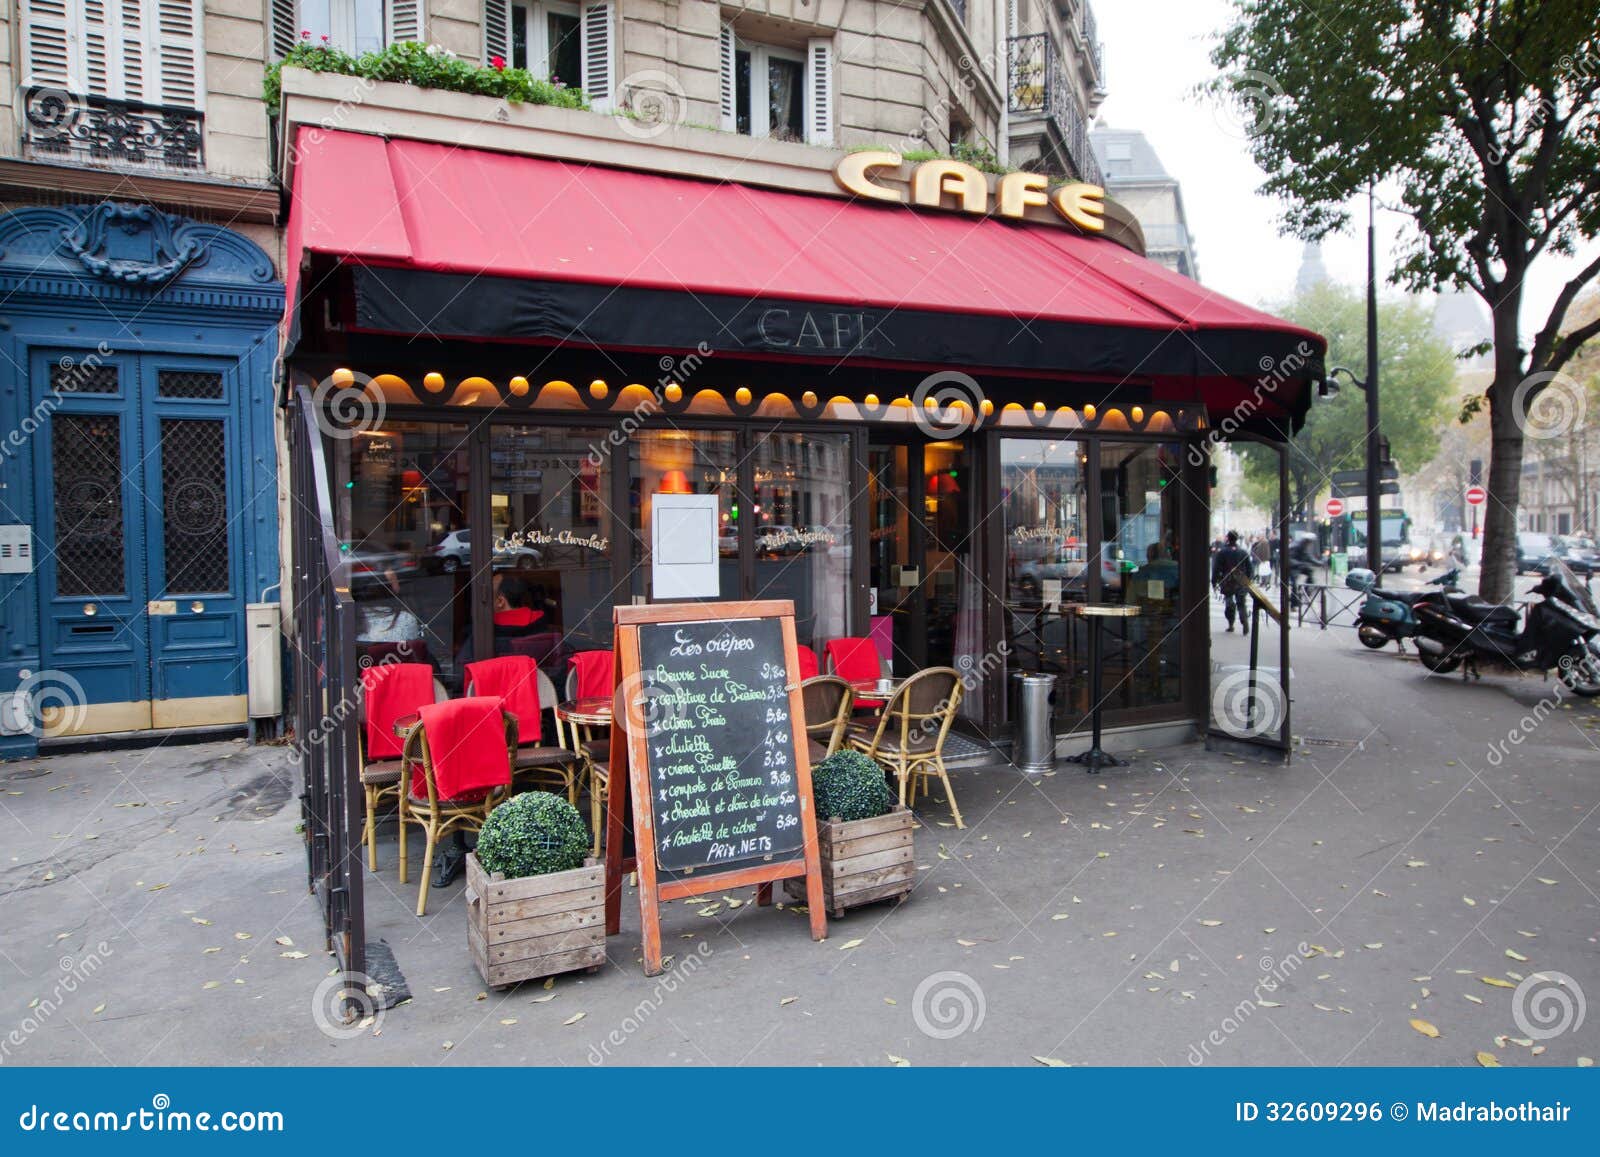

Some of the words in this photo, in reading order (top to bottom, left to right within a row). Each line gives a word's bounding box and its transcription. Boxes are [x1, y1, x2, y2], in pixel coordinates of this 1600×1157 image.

[832, 151, 1104, 231] CAFE
[670, 629, 702, 656] Les
[657, 664, 697, 683] Beurre
[700, 664, 730, 680] Sucre
[710, 687, 726, 703] de
[696, 705, 726, 728] Frais
[665, 733, 713, 755] Nutella
[711, 777, 724, 792] de
[715, 798, 726, 813] et
[750, 794, 761, 808] de
[716, 824, 729, 839] de
